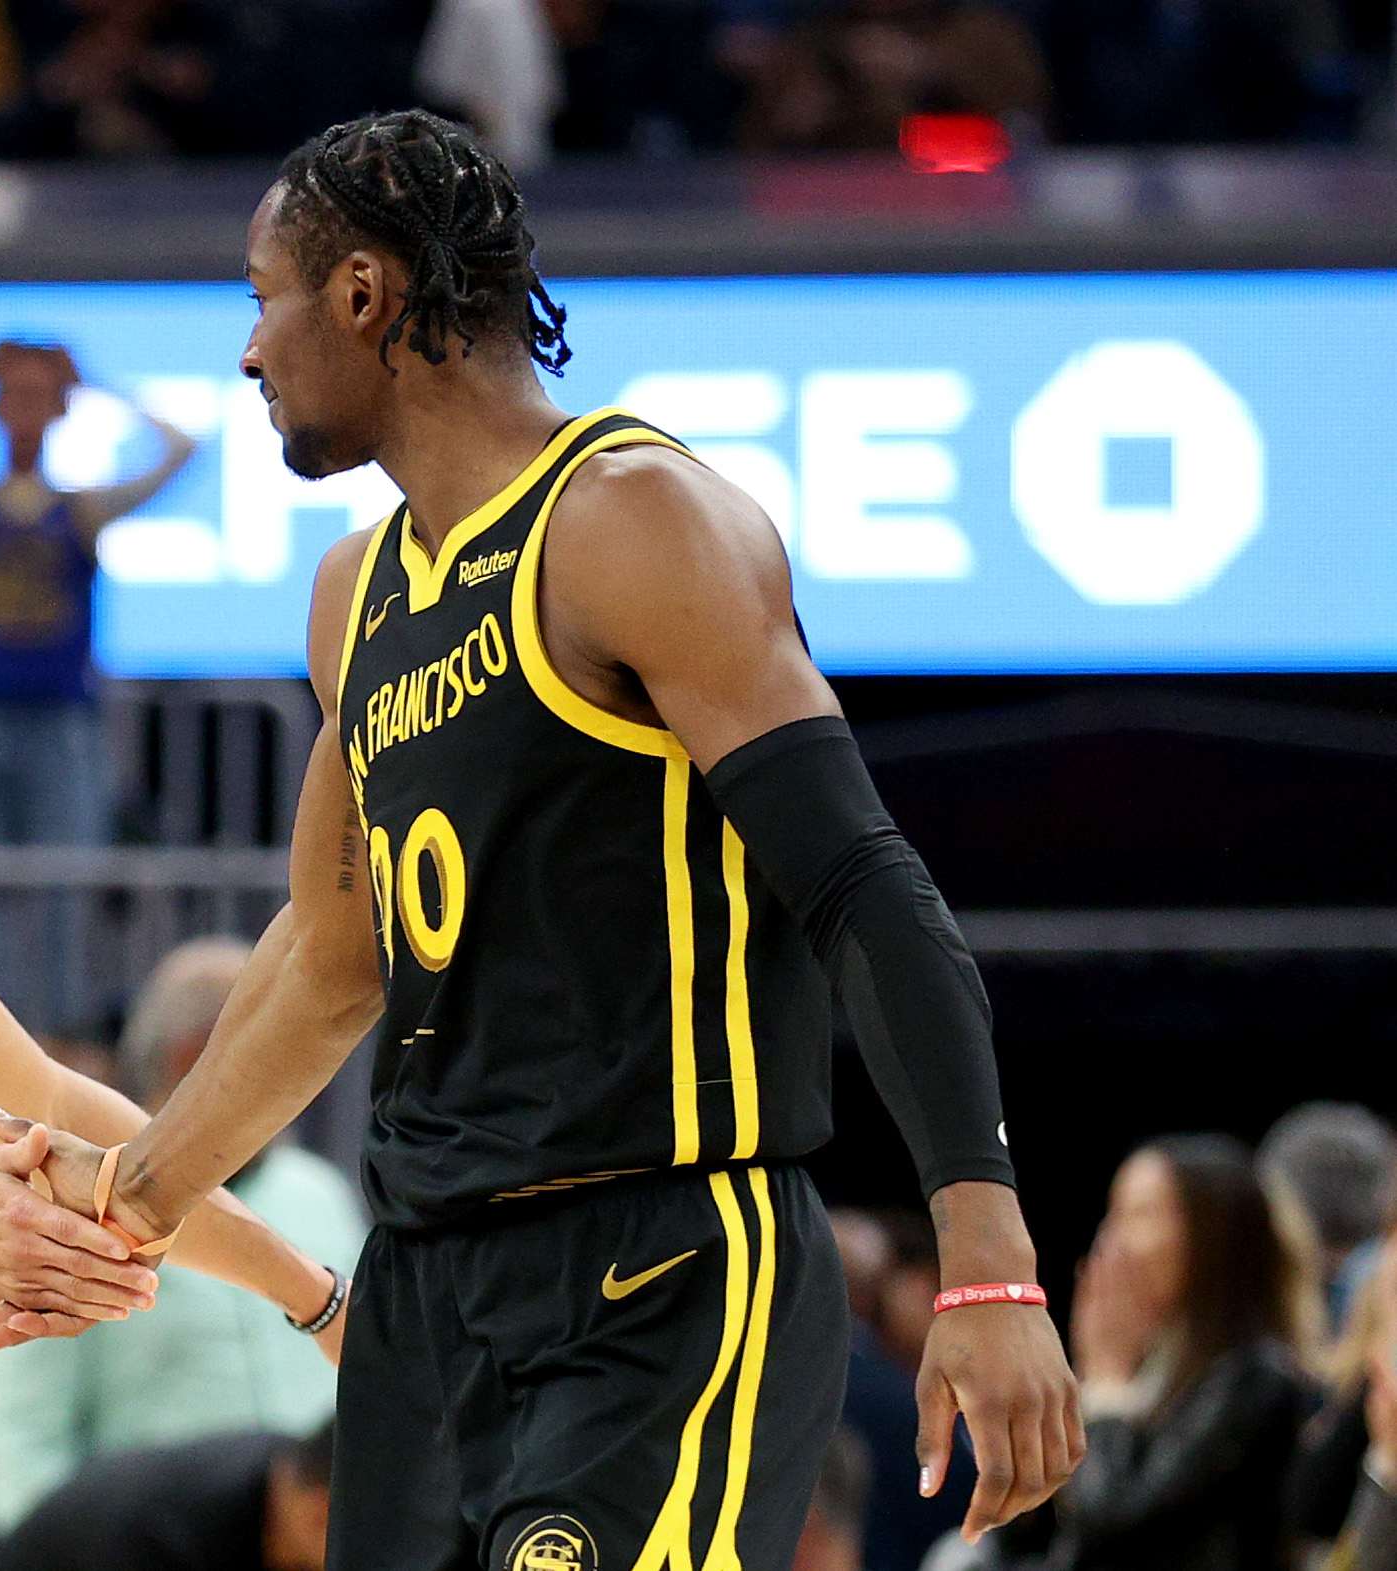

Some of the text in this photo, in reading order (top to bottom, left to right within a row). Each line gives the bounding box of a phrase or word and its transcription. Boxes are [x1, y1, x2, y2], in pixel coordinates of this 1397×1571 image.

[41, 368, 975, 582] CHSE
[458, 550, 518, 585] Rakuten
[366, 612, 509, 763] FRANCISCO
[964, 1287, 1006, 1302] Bryant
